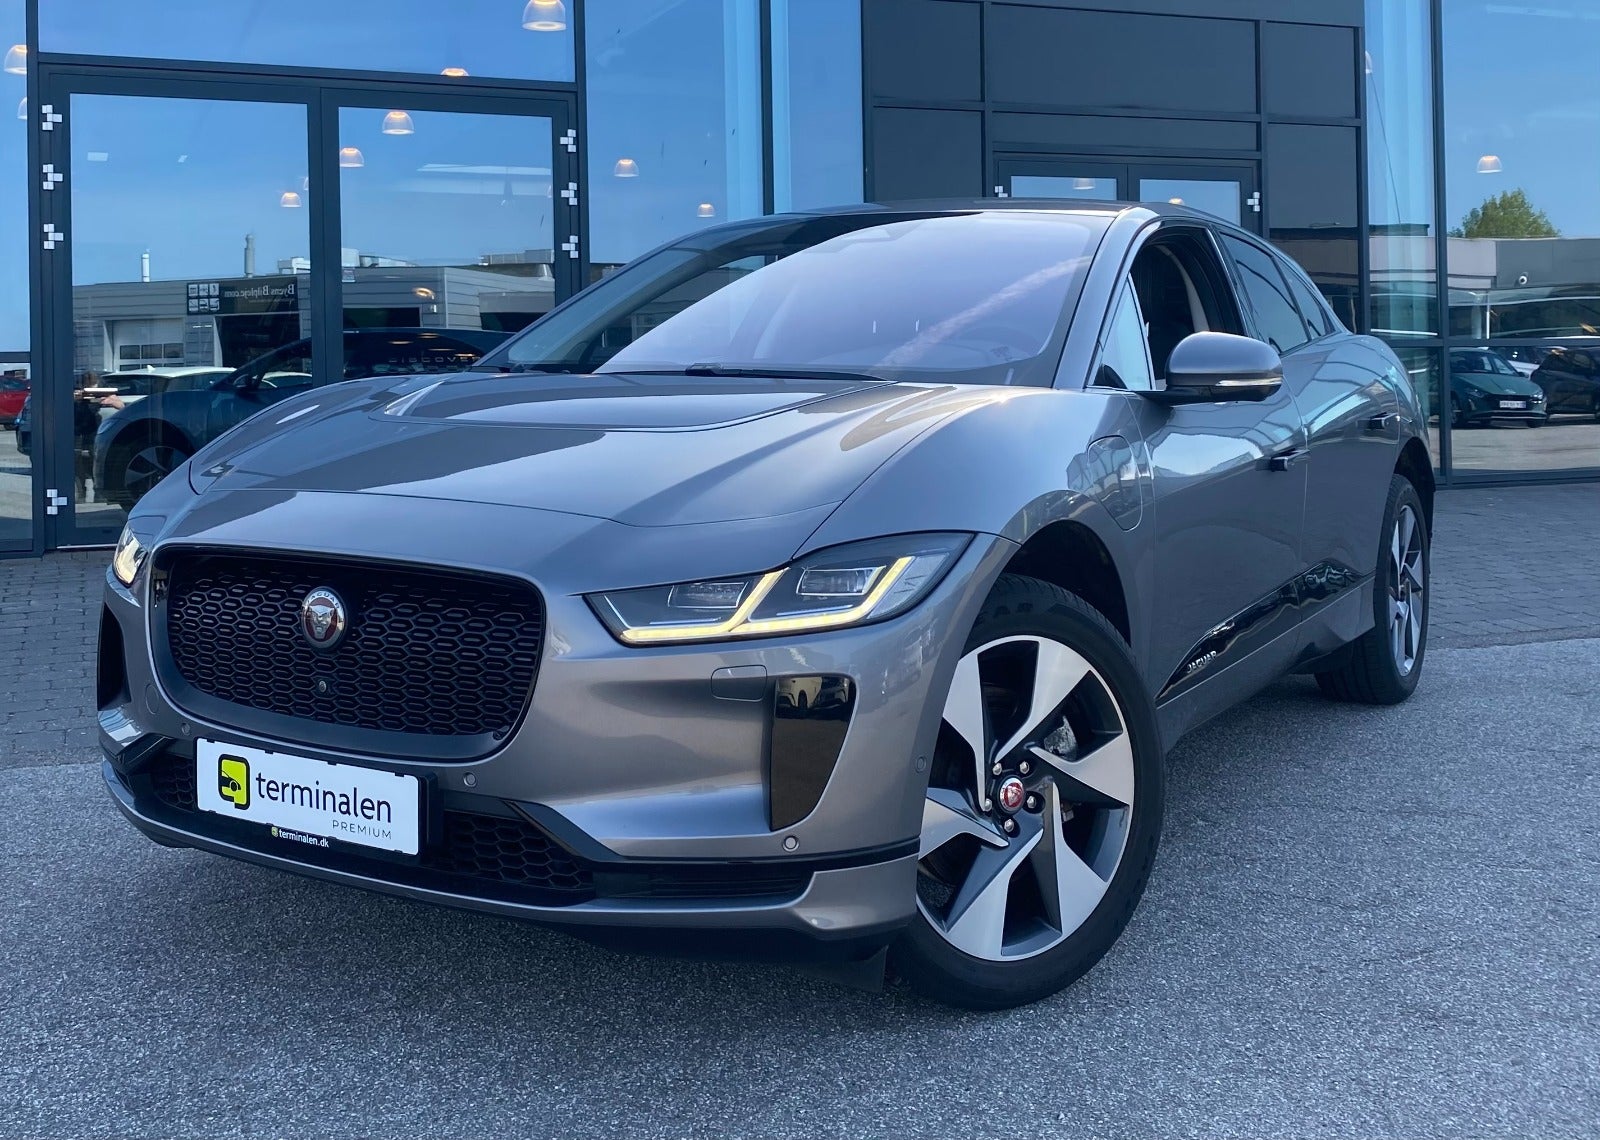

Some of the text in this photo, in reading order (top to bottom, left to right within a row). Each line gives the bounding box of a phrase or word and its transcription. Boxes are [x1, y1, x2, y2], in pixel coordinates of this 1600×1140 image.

[1186, 650, 1217, 674] JAGUAR
[255, 772, 392, 823] terminalen
[278, 828, 329, 848] terminalen.dk
[332, 819, 392, 840] PREMIUM
